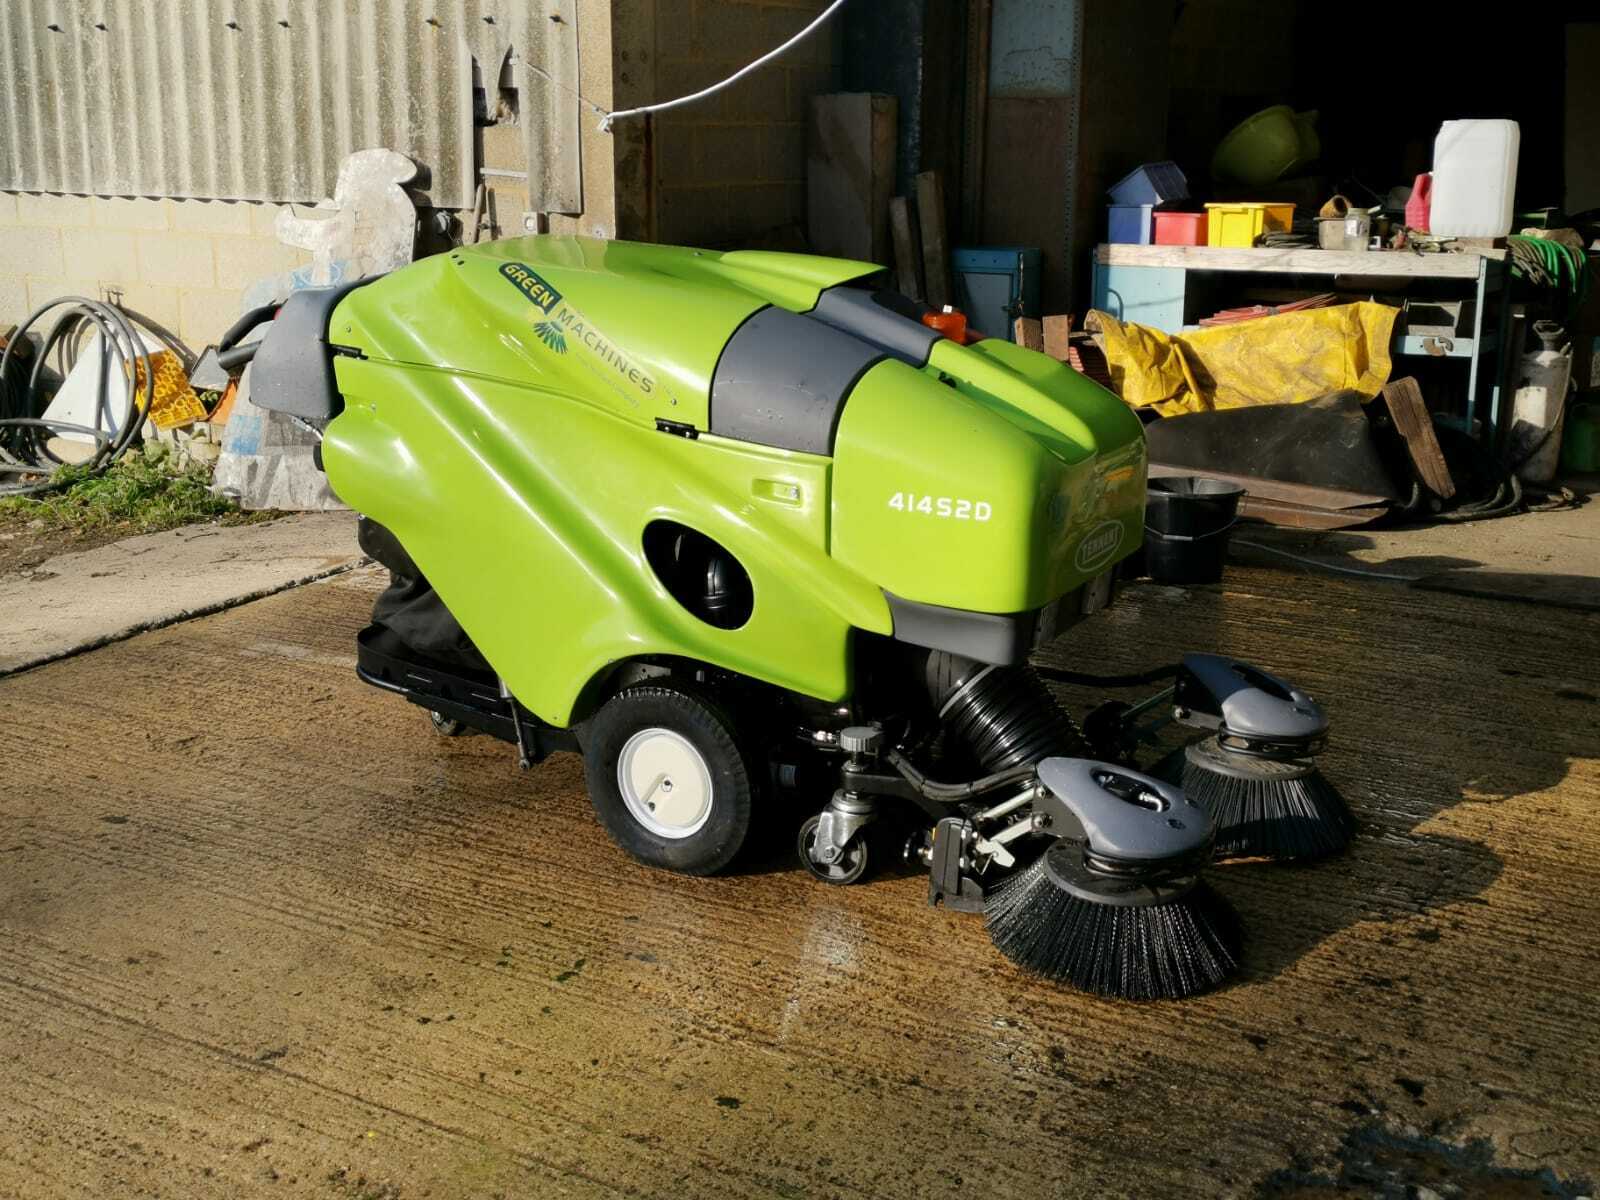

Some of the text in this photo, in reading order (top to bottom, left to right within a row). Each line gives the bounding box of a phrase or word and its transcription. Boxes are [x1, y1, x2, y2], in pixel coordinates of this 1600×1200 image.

[504, 264, 554, 308] GREEN
[557, 308, 655, 393] MACHINES
[888, 492, 992, 522] 414S2D
